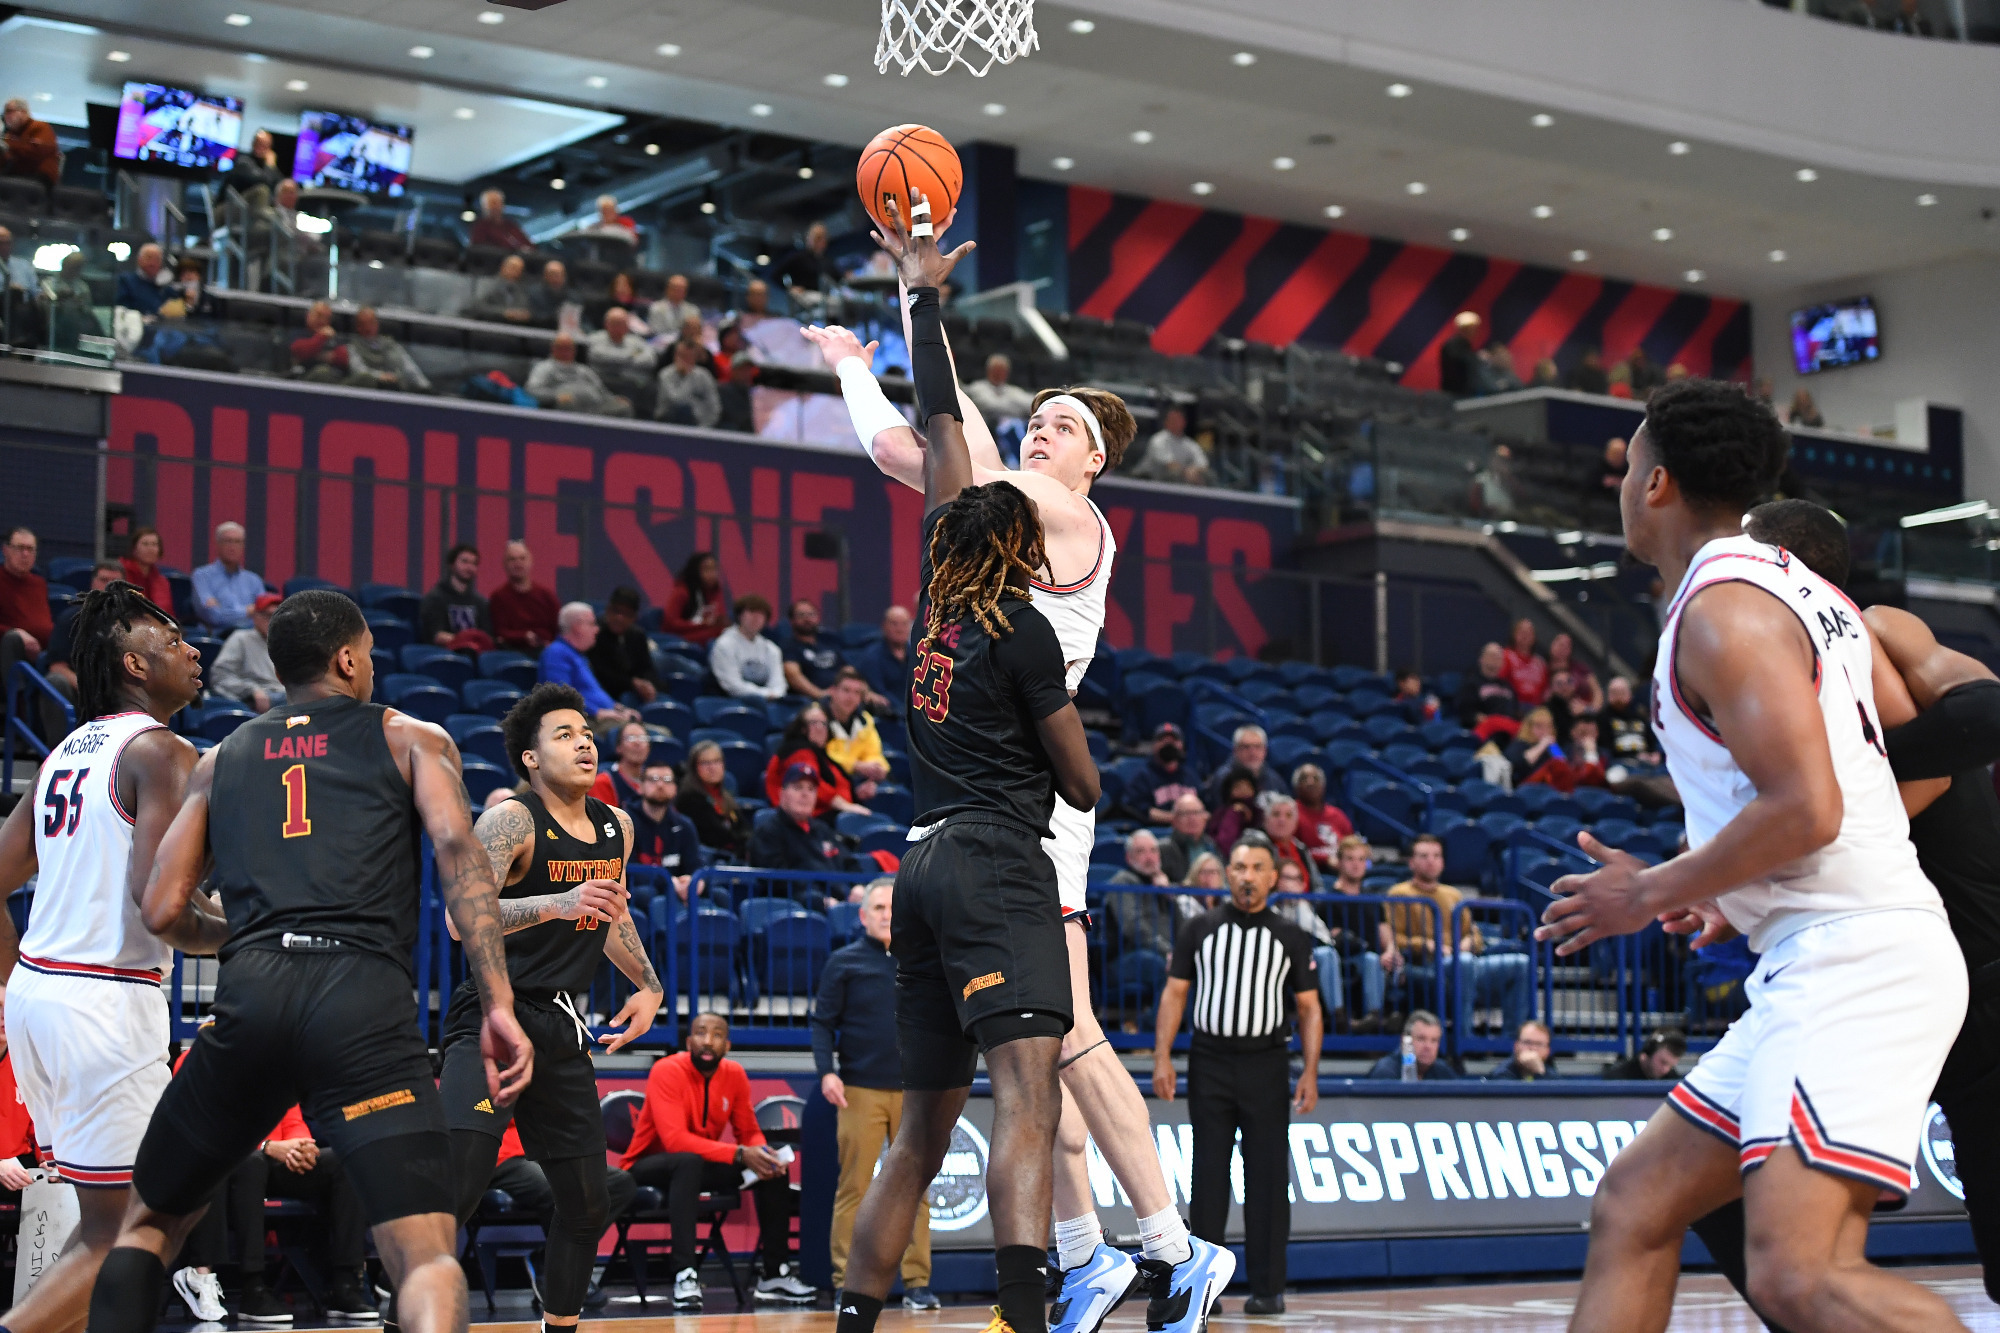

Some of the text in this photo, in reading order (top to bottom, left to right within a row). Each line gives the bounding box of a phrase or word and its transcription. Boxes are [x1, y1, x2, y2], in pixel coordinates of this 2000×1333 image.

[911, 637, 954, 724] 23
[264, 734, 329, 760] LANE
[44, 766, 91, 838] 55
[282, 764, 311, 839] 1
[547, 857, 622, 882] WINTHROP
